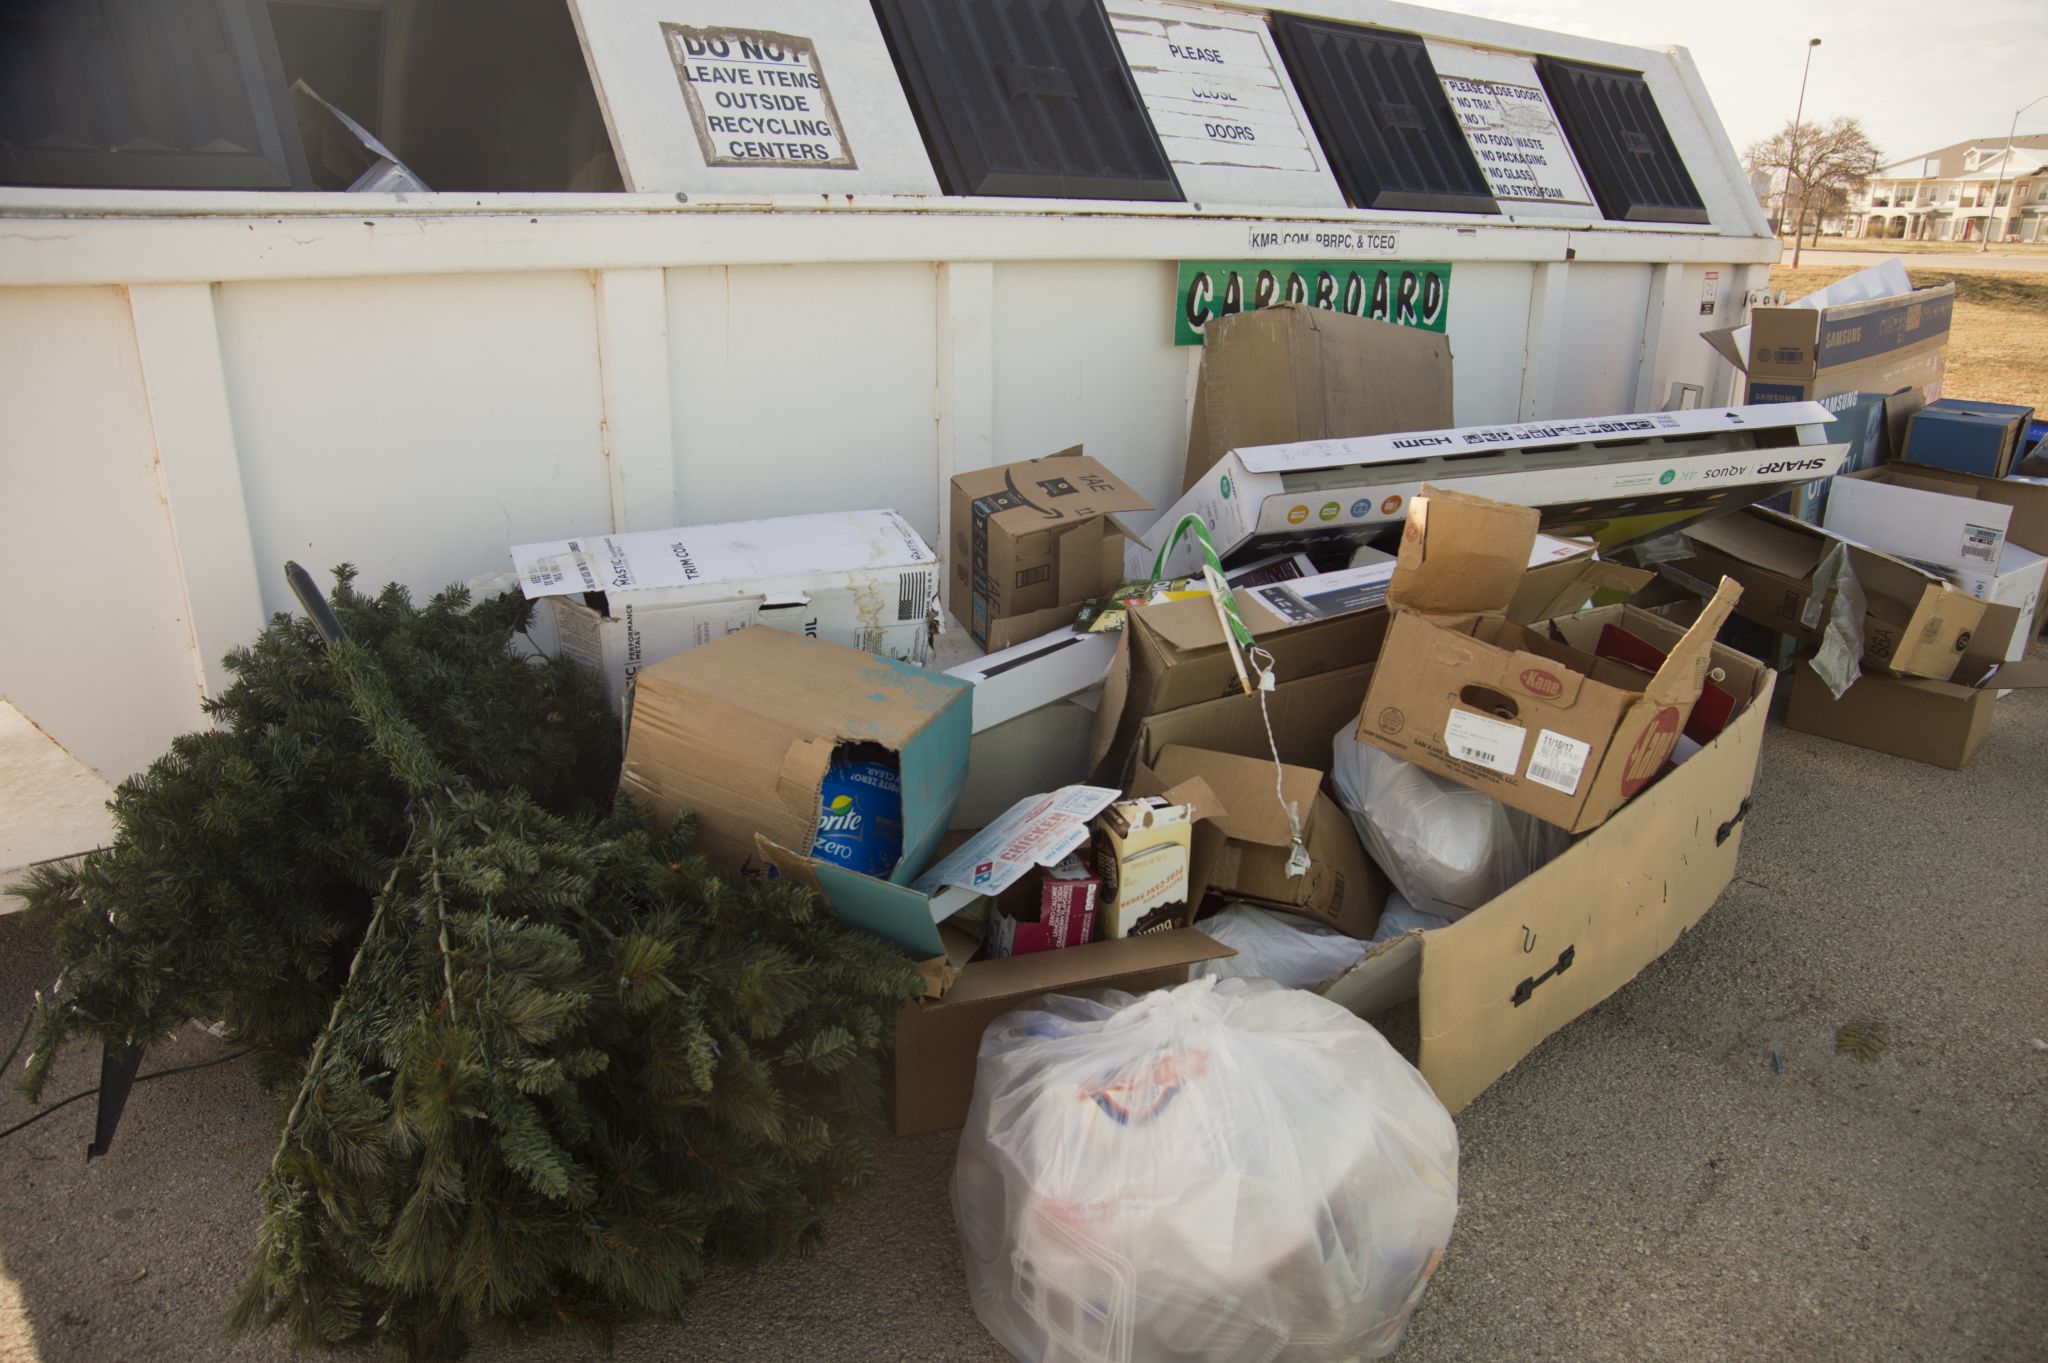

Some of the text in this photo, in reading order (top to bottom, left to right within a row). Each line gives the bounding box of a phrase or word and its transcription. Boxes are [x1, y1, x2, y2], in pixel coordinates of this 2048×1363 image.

[683, 36, 730, 58] DO
[1169, 44, 1224, 64] PLEASE
[684, 65, 821, 89] LEAVE ITEMS
[1449, 81, 1543, 102] PLEASE CLOSE DOORS
[715, 91, 810, 112] OUTSIDE
[1457, 97, 1471, 108] NO
[708, 115, 832, 136] RECYCLING
[1464, 113, 1479, 125] NO
[1205, 123, 1256, 141] DOORS
[1473, 133, 1545, 150] NO FOOD WASTE
[729, 141, 829, 160] CENTERS
[1481, 150, 1547, 166] NO PACKAGING
[1488, 167, 1534, 181] NO GLASS
[1496, 184, 1564, 198] NO STYROFOAM
[1357, 235, 1363, 248] &
[1367, 235, 1395, 249] TCEQ
[1825, 326, 1862, 349] SAMSUNG
[1755, 393, 1797, 402] SAMSUNG
[1392, 436, 1452, 449] HDMI
[1704, 465, 1748, 479] AQUOS
[1757, 458, 1826, 475] SHARP
[671, 541, 700, 581] TRIM COIL
[626, 604, 635, 660] PERFORMANCE
[1526, 669, 1561, 696] Kane
[819, 806, 862, 831] prite
[1000, 811, 1068, 862] CHICKEN
[815, 837, 852, 859] zero
